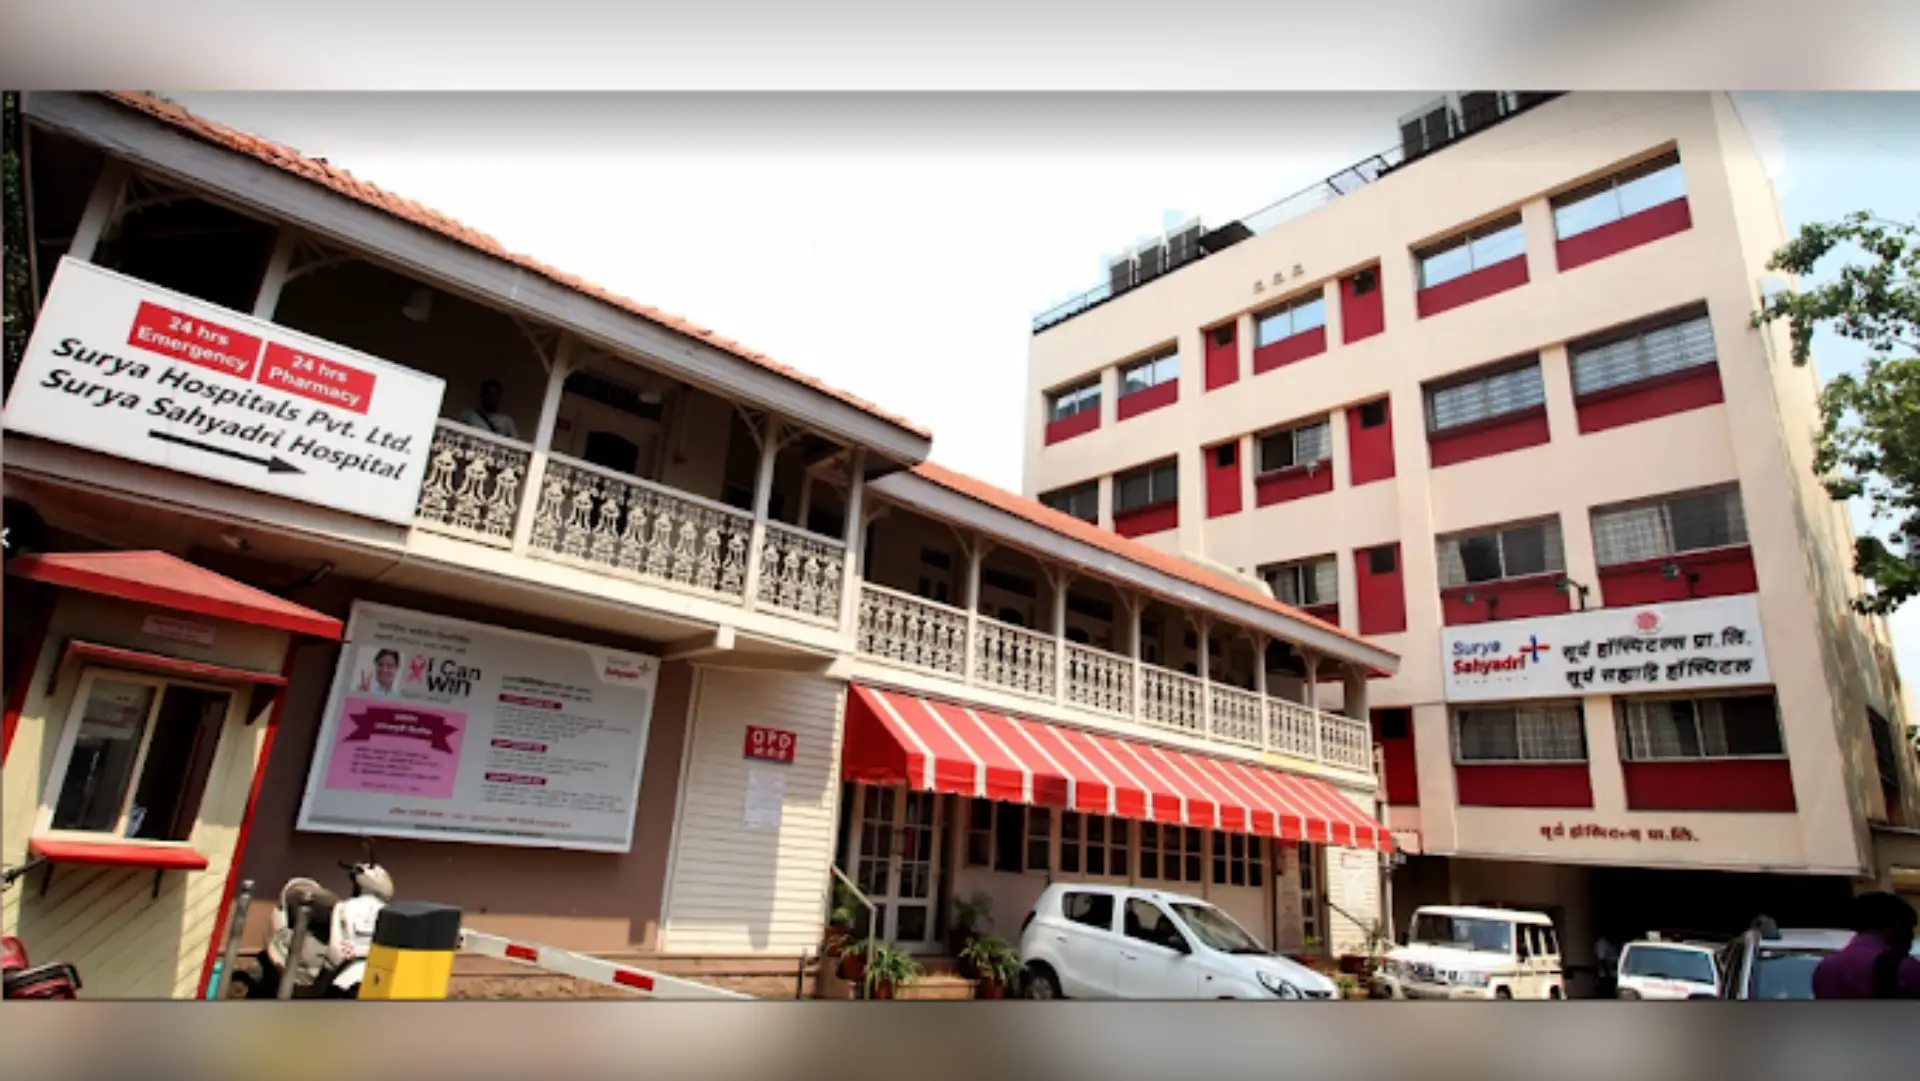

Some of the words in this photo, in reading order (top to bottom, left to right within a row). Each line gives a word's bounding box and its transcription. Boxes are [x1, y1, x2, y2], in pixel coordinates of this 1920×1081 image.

[168, 314, 193, 334] 24
[197, 325, 229, 346] hrs
[137, 324, 249, 373] Emergency
[291, 354, 314, 373] 24
[319, 362, 348, 383] hrs
[52, 338, 151, 378] Surya
[157, 366, 301, 421] Hospitals
[305, 409, 356, 438] Pvt.
[365, 425, 412, 454] Ltd.
[267, 366, 362, 407] Pharmacy
[39, 369, 141, 408] Surya
[146, 397, 286, 448] Sahyadri
[288, 434, 407, 480] Hospital
[1453, 640, 1501, 657] Surya
[1562, 639, 1591, 664] सूर्य
[428, 656, 436, 674] I
[440, 659, 481, 681] Can
[1453, 654, 1526, 676] Sahyadri
[1566, 665, 1595, 689] सूर्य
